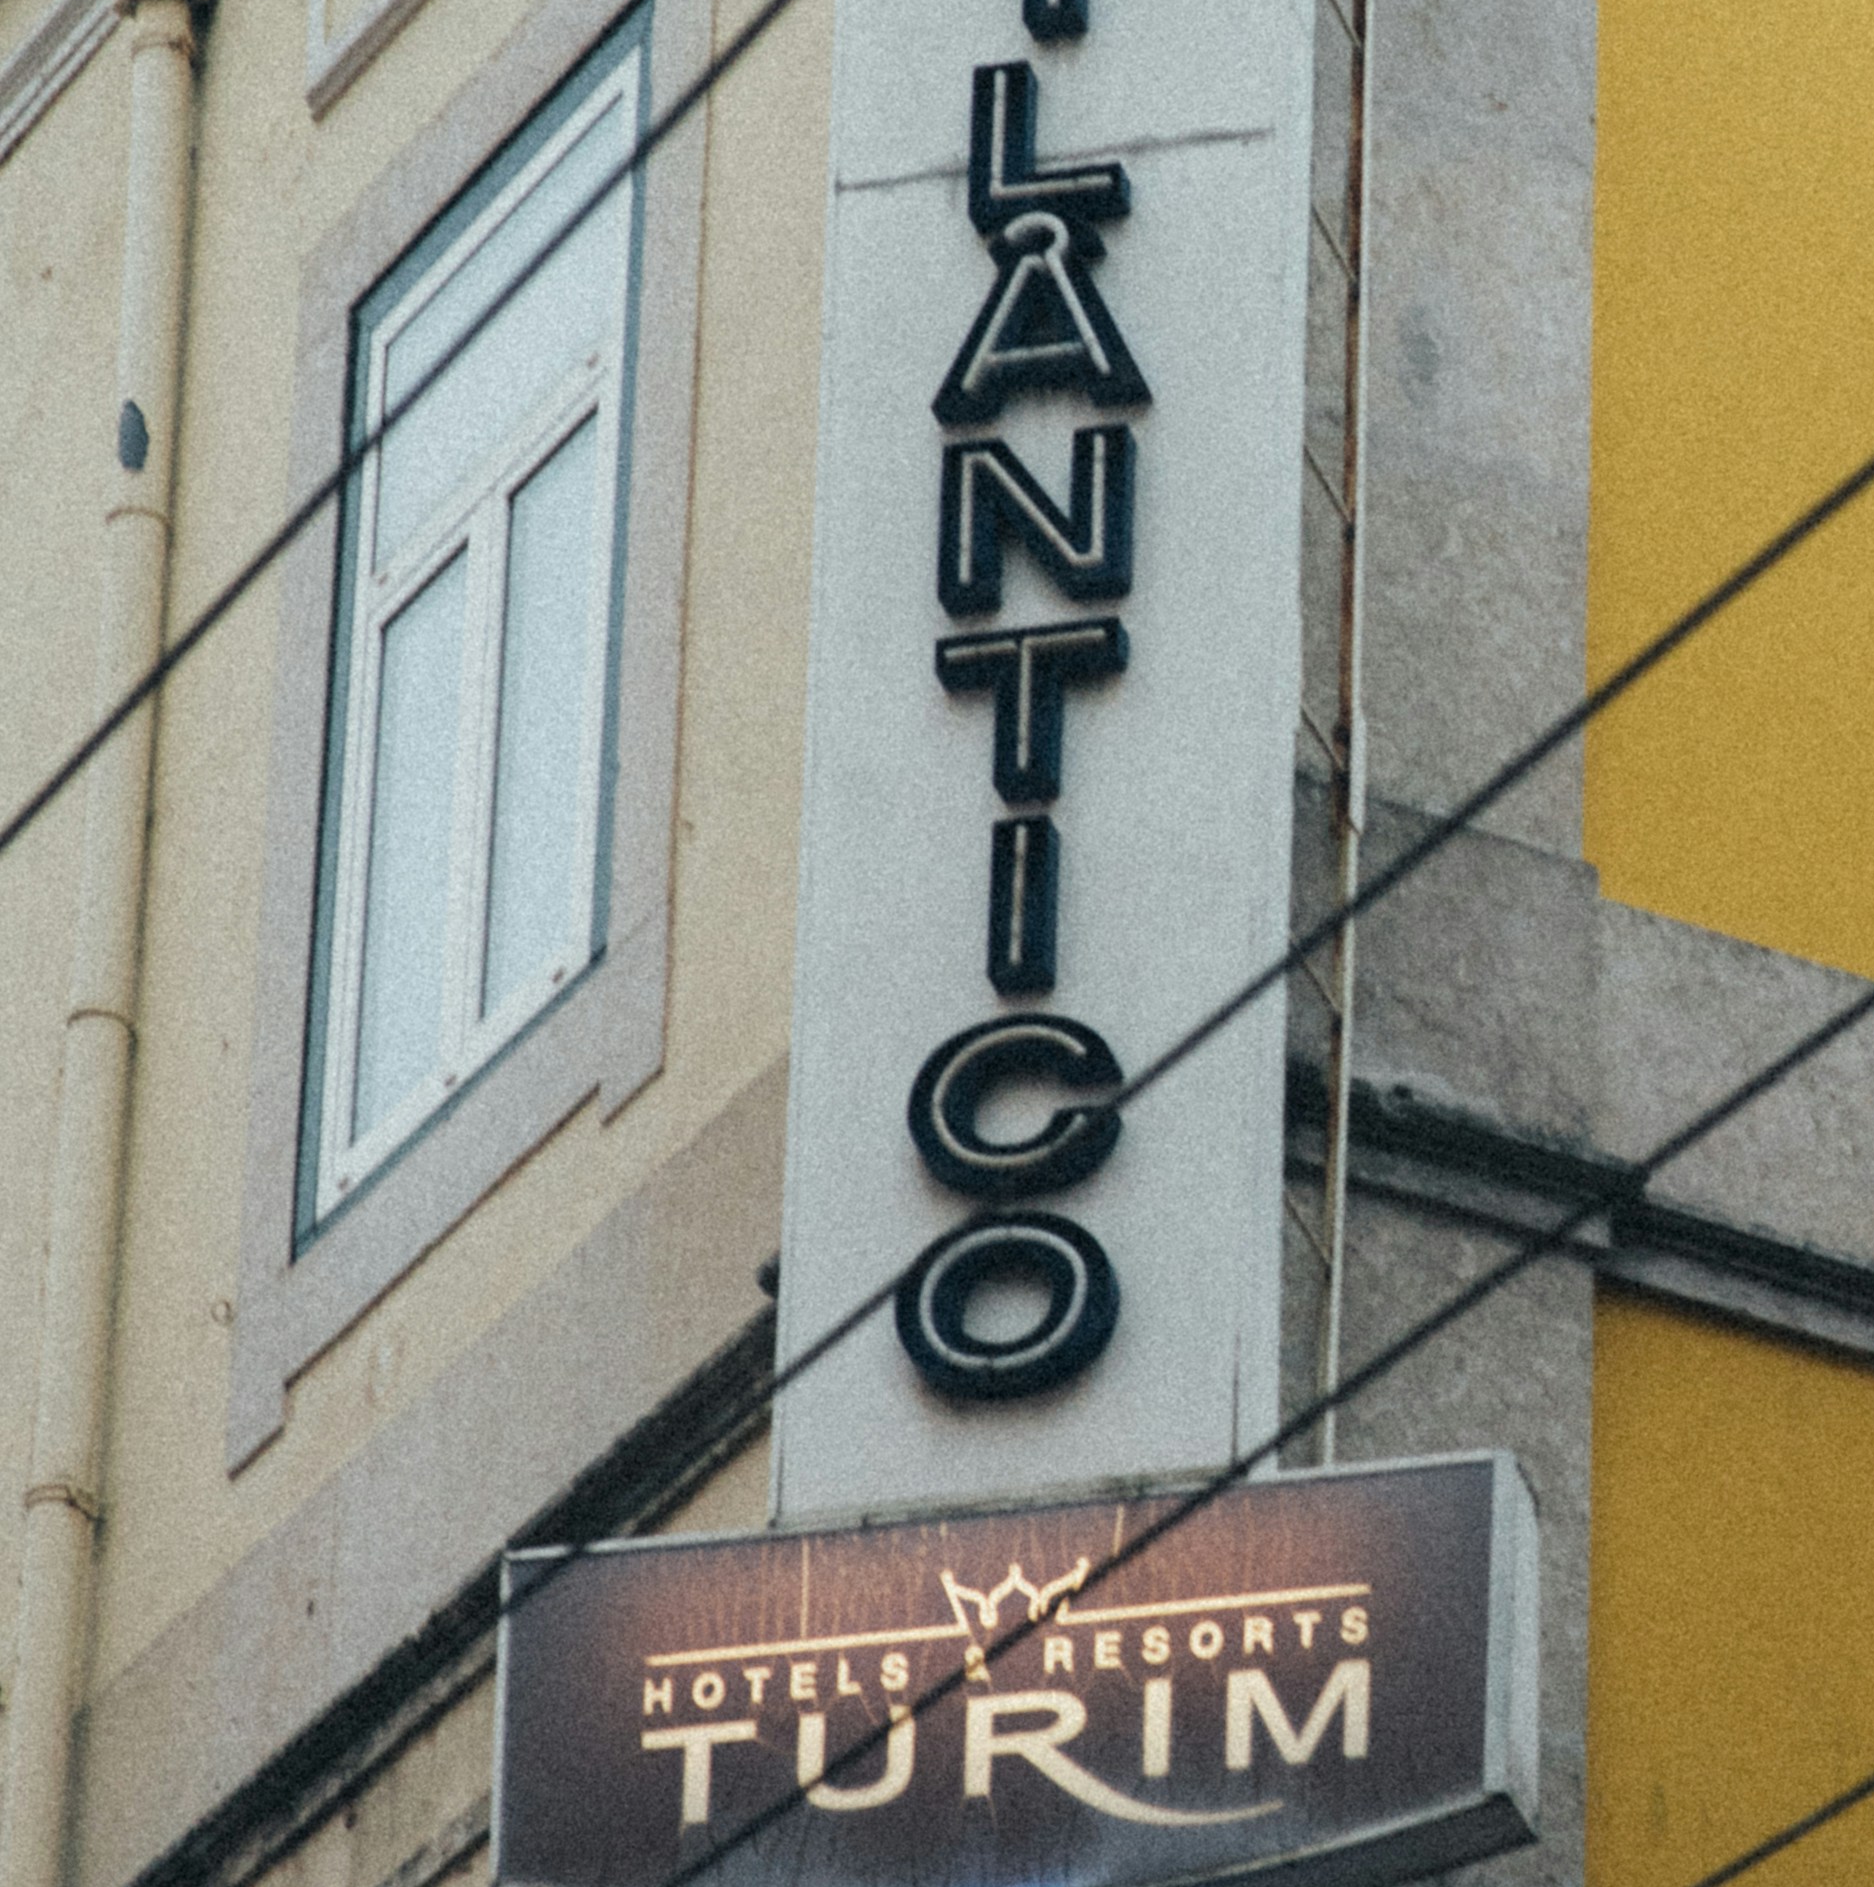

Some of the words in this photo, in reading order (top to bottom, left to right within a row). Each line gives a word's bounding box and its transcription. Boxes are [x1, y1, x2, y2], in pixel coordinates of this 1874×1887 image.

[642, 1655, 910, 1716] HOTELS
[964, 1643, 992, 1682] &
[1043, 1606, 1370, 1675] RESORTS
[641, 1658, 1371, 1827] TURIM
